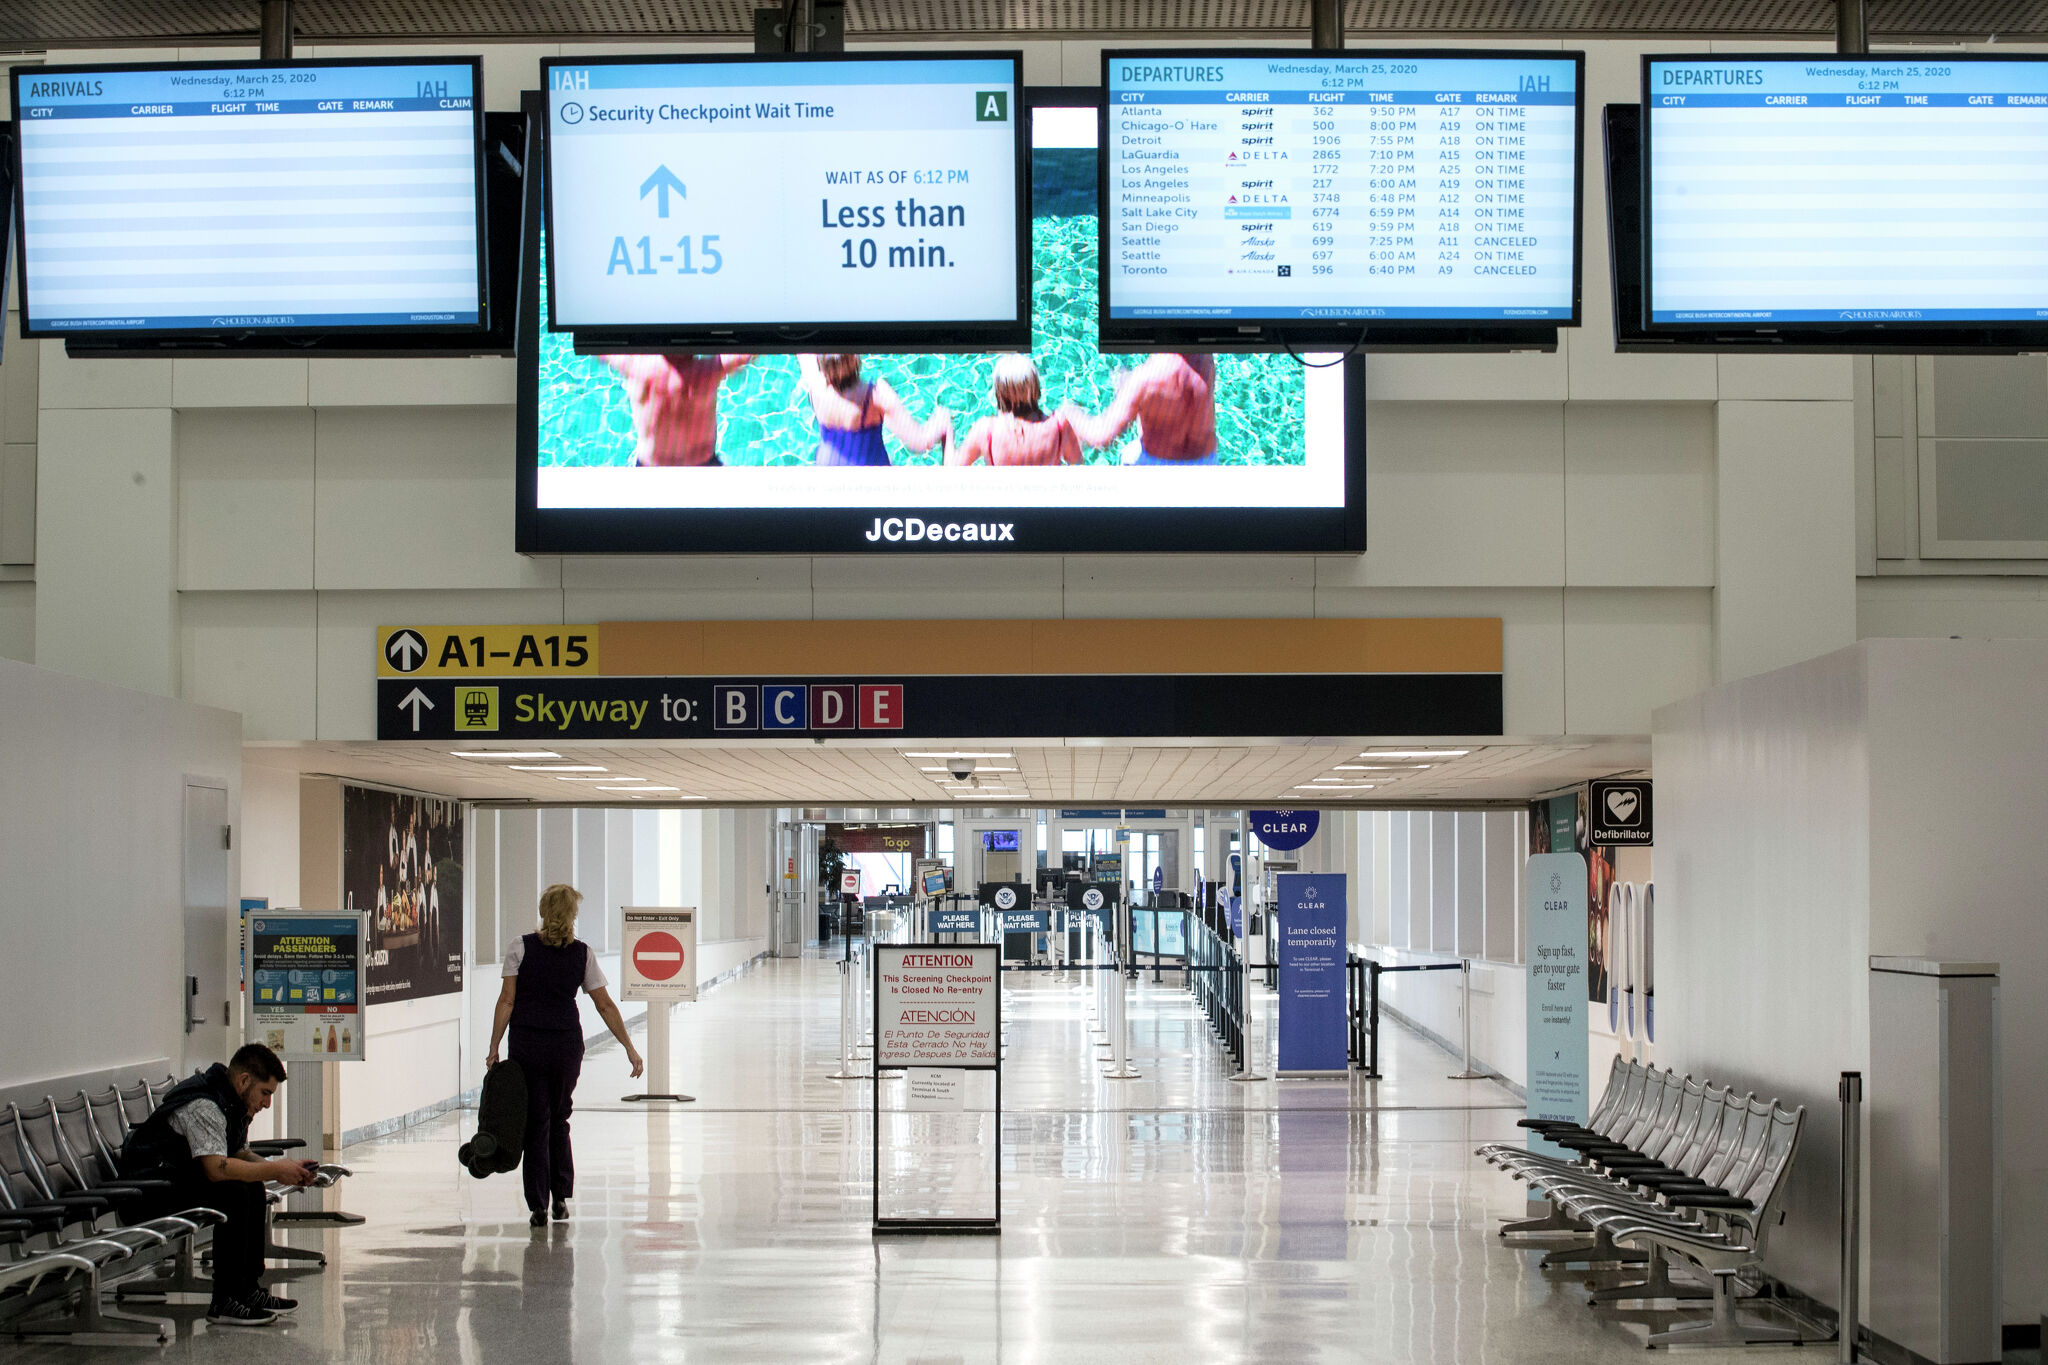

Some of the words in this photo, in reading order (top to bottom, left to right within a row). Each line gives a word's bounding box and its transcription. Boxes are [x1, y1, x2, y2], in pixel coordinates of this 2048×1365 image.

[1121, 66, 1224, 82] DEPARTURES
[1267, 64, 1332, 74] Wednesday,
[1335, 64, 1369, 74] March
[1371, 65, 1387, 75] 25,
[1391, 65, 1418, 74] 2020
[1805, 67, 1869, 78] Wednesday,
[1871, 67, 1903, 77] March
[1905, 67, 1922, 78] 25,
[1924, 67, 1951, 77] 2020
[171, 76, 233, 87] Wednesday,
[236, 75, 269, 84] March
[272, 74, 287, 85] 25,
[290, 73, 317, 83] 2020
[554, 70, 590, 90] IAH
[1321, 78, 1344, 87] 6:12
[1347, 79, 1364, 87] PM
[1519, 75, 1550, 92] IAH
[1662, 70, 1763, 86] DEPARTURES
[30, 80, 103, 98] ARRIVALS
[416, 80, 448, 98] IAH
[1858, 80, 1880, 90] 6:12
[1883, 80, 1899, 90] PM
[223, 89, 245, 98] 6:12
[248, 89, 264, 98] PM
[1121, 93, 1145, 102] CITY
[1226, 92, 1270, 102] CARRIER
[1308, 93, 1345, 102] FLIGHT
[1369, 93, 1394, 103] TIME
[1435, 93, 1462, 103] GATE
[1476, 93, 1518, 103] REMARK
[1662, 96, 1686, 105] CITY
[1765, 96, 1808, 105] CARRIER
[1846, 96, 1881, 105] FLIGHT
[1904, 96, 1928, 105] TIME
[1968, 96, 1994, 105] GATE
[2007, 96, 2048, 105] REMARK
[30, 108, 54, 117] CITY
[131, 105, 173, 115] CARRIER
[211, 103, 247, 113] FLIGHT
[255, 103, 280, 112] TIME
[317, 102, 344, 111] GATE
[353, 101, 394, 110] REMARK
[439, 99, 471, 108] CLAIM
[983, 96, 1000, 118] A
[1121, 107, 1162, 116] Atlanta
[1241, 107, 1274, 117] spirit
[1313, 107, 1334, 116] 362
[1370, 107, 1395, 116] 9:50
[1399, 107, 1416, 116] PM
[1440, 107, 1460, 116] A17
[1475, 107, 1494, 116] ON
[1498, 107, 1526, 116] TIME
[589, 105, 654, 124] Security
[658, 104, 751, 123] Checkpoint
[755, 103, 791, 120] Wait
[795, 102, 834, 120] Time
[825, 171, 861, 185] WAIT
[867, 171, 884, 184] AS
[889, 170, 908, 184] OF
[913, 170, 943, 184] 6:12
[947, 170, 969, 184] PM
[821, 199, 885, 229] Less
[895, 198, 966, 227] than
[1121, 237, 1161, 246] Seattle
[1240, 236, 1275, 247] Alaska
[1312, 237, 1334, 246] 699
[1369, 237, 1393, 246] 7:25
[1396, 237, 1414, 246] PM
[1438, 237, 1459, 246] A11
[1474, 237, 1537, 246] CANCELED
[606, 235, 723, 276] A1-15
[841, 238, 877, 269] 10
[888, 238, 956, 268] min.
[865, 517, 1015, 542] JCDecaux
[514, 693, 649, 731] Skyway
[660, 694, 699, 722] to:
[727, 691, 747, 725] B
[774, 691, 795, 725] C
[822, 690, 844, 724] D
[873, 690, 890, 724] E
[1262, 823, 1307, 833] CLEAR
[1594, 829, 1650, 840] Defibrillator
[883, 836, 895, 847] To
[896, 839, 910, 852] go
[1544, 901, 1568, 911] CLEAR
[943, 914, 969, 922] PLEASE
[1007, 914, 1035, 922] PLEASE
[937, 921, 954, 929] WAIT
[956, 921, 975, 929] HERE
[1022, 920, 1040, 929] HERE
[1287, 926, 1308, 935] Lane
[1310, 925, 1337, 935] closed
[279, 936, 330, 945] ATTENTION
[1287, 937, 1337, 948] temporarily
[273, 945, 337, 953] PASSENGERS
[1537, 945, 1552, 960] Sign
[1552, 948, 1561, 960] up
[1561, 944, 1576, 958] fast,
[902, 955, 973, 966] ATTENTION
[1533, 965, 1543, 977] get
[1544, 964, 1550, 973] to
[1551, 966, 1566, 977] your
[1566, 964, 1581, 977] gate
[883, 975, 899, 983] This
[902, 975, 943, 984] Screening
[946, 975, 992, 984] Checkpoint
[1547, 979, 1566, 991] faster
[891, 986, 898, 994] Is
[901, 986, 930, 994] Closed
[933, 986, 944, 994] No
[947, 986, 983, 995] Re-entry
[900, 1007, 975, 1022] ATENCIÓN
[884, 1031, 894, 1039] El
[896, 1031, 924, 1039] Punto
[927, 1031, 940, 1039] De
[944, 1031, 990, 1040] Seguridad
[887, 1041, 908, 1049] Esta
[912, 1041, 949, 1049] Cerrado
[952, 1041, 966, 1049] No
[969, 1041, 987, 1050] Hay
[913, 1051, 952, 1060] Despues
[955, 1051, 967, 1059] De
